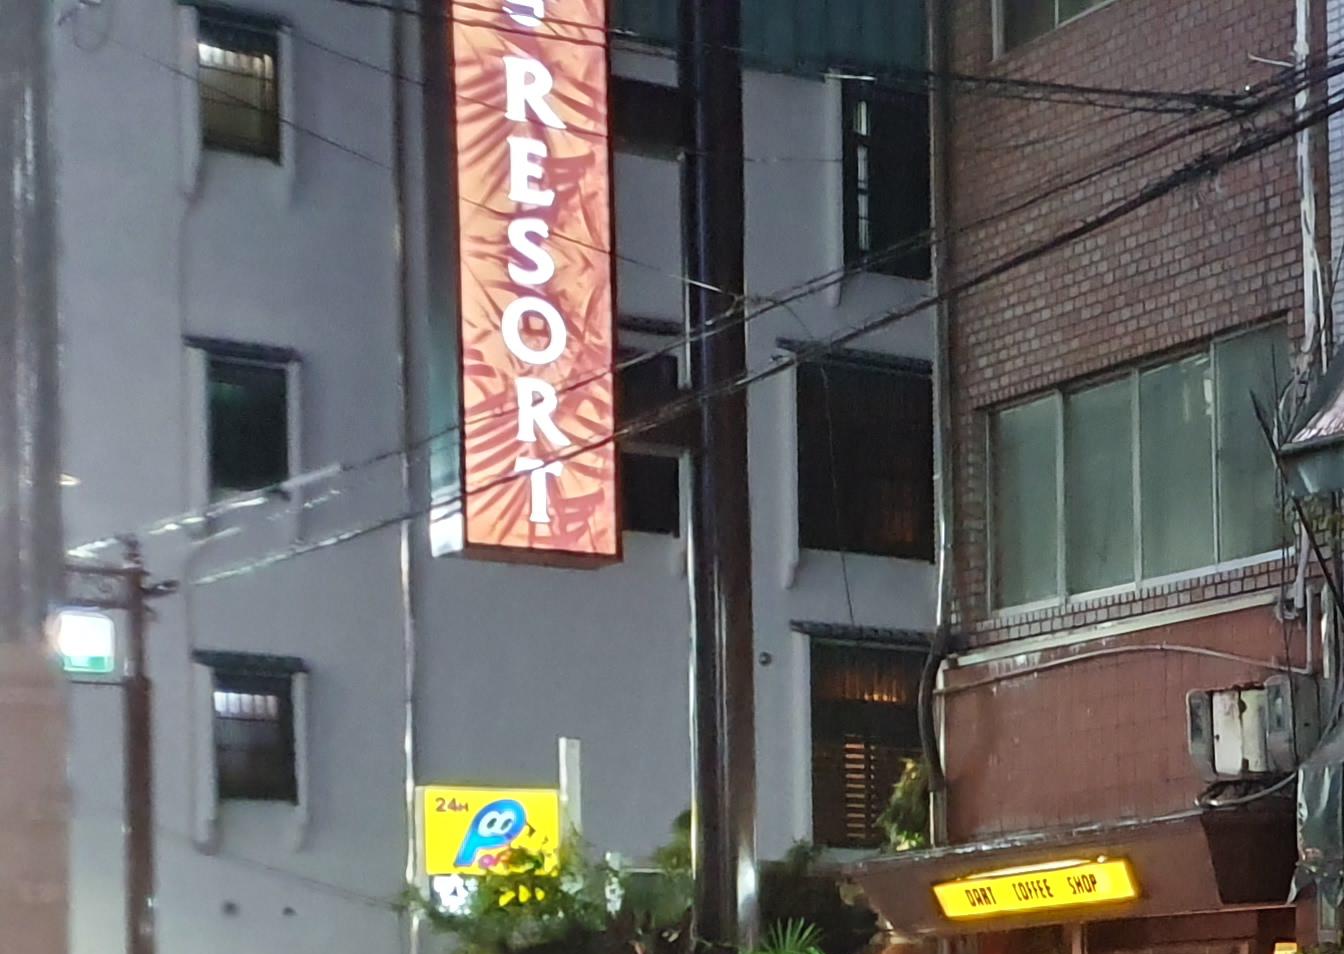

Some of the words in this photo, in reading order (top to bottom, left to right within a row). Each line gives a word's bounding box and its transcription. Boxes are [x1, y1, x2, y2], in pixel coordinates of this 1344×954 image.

[501, 54, 574, 526] RESORT
[1011, 878, 1055, 902] COFFEE
[1066, 872, 1098, 896] SHOP
